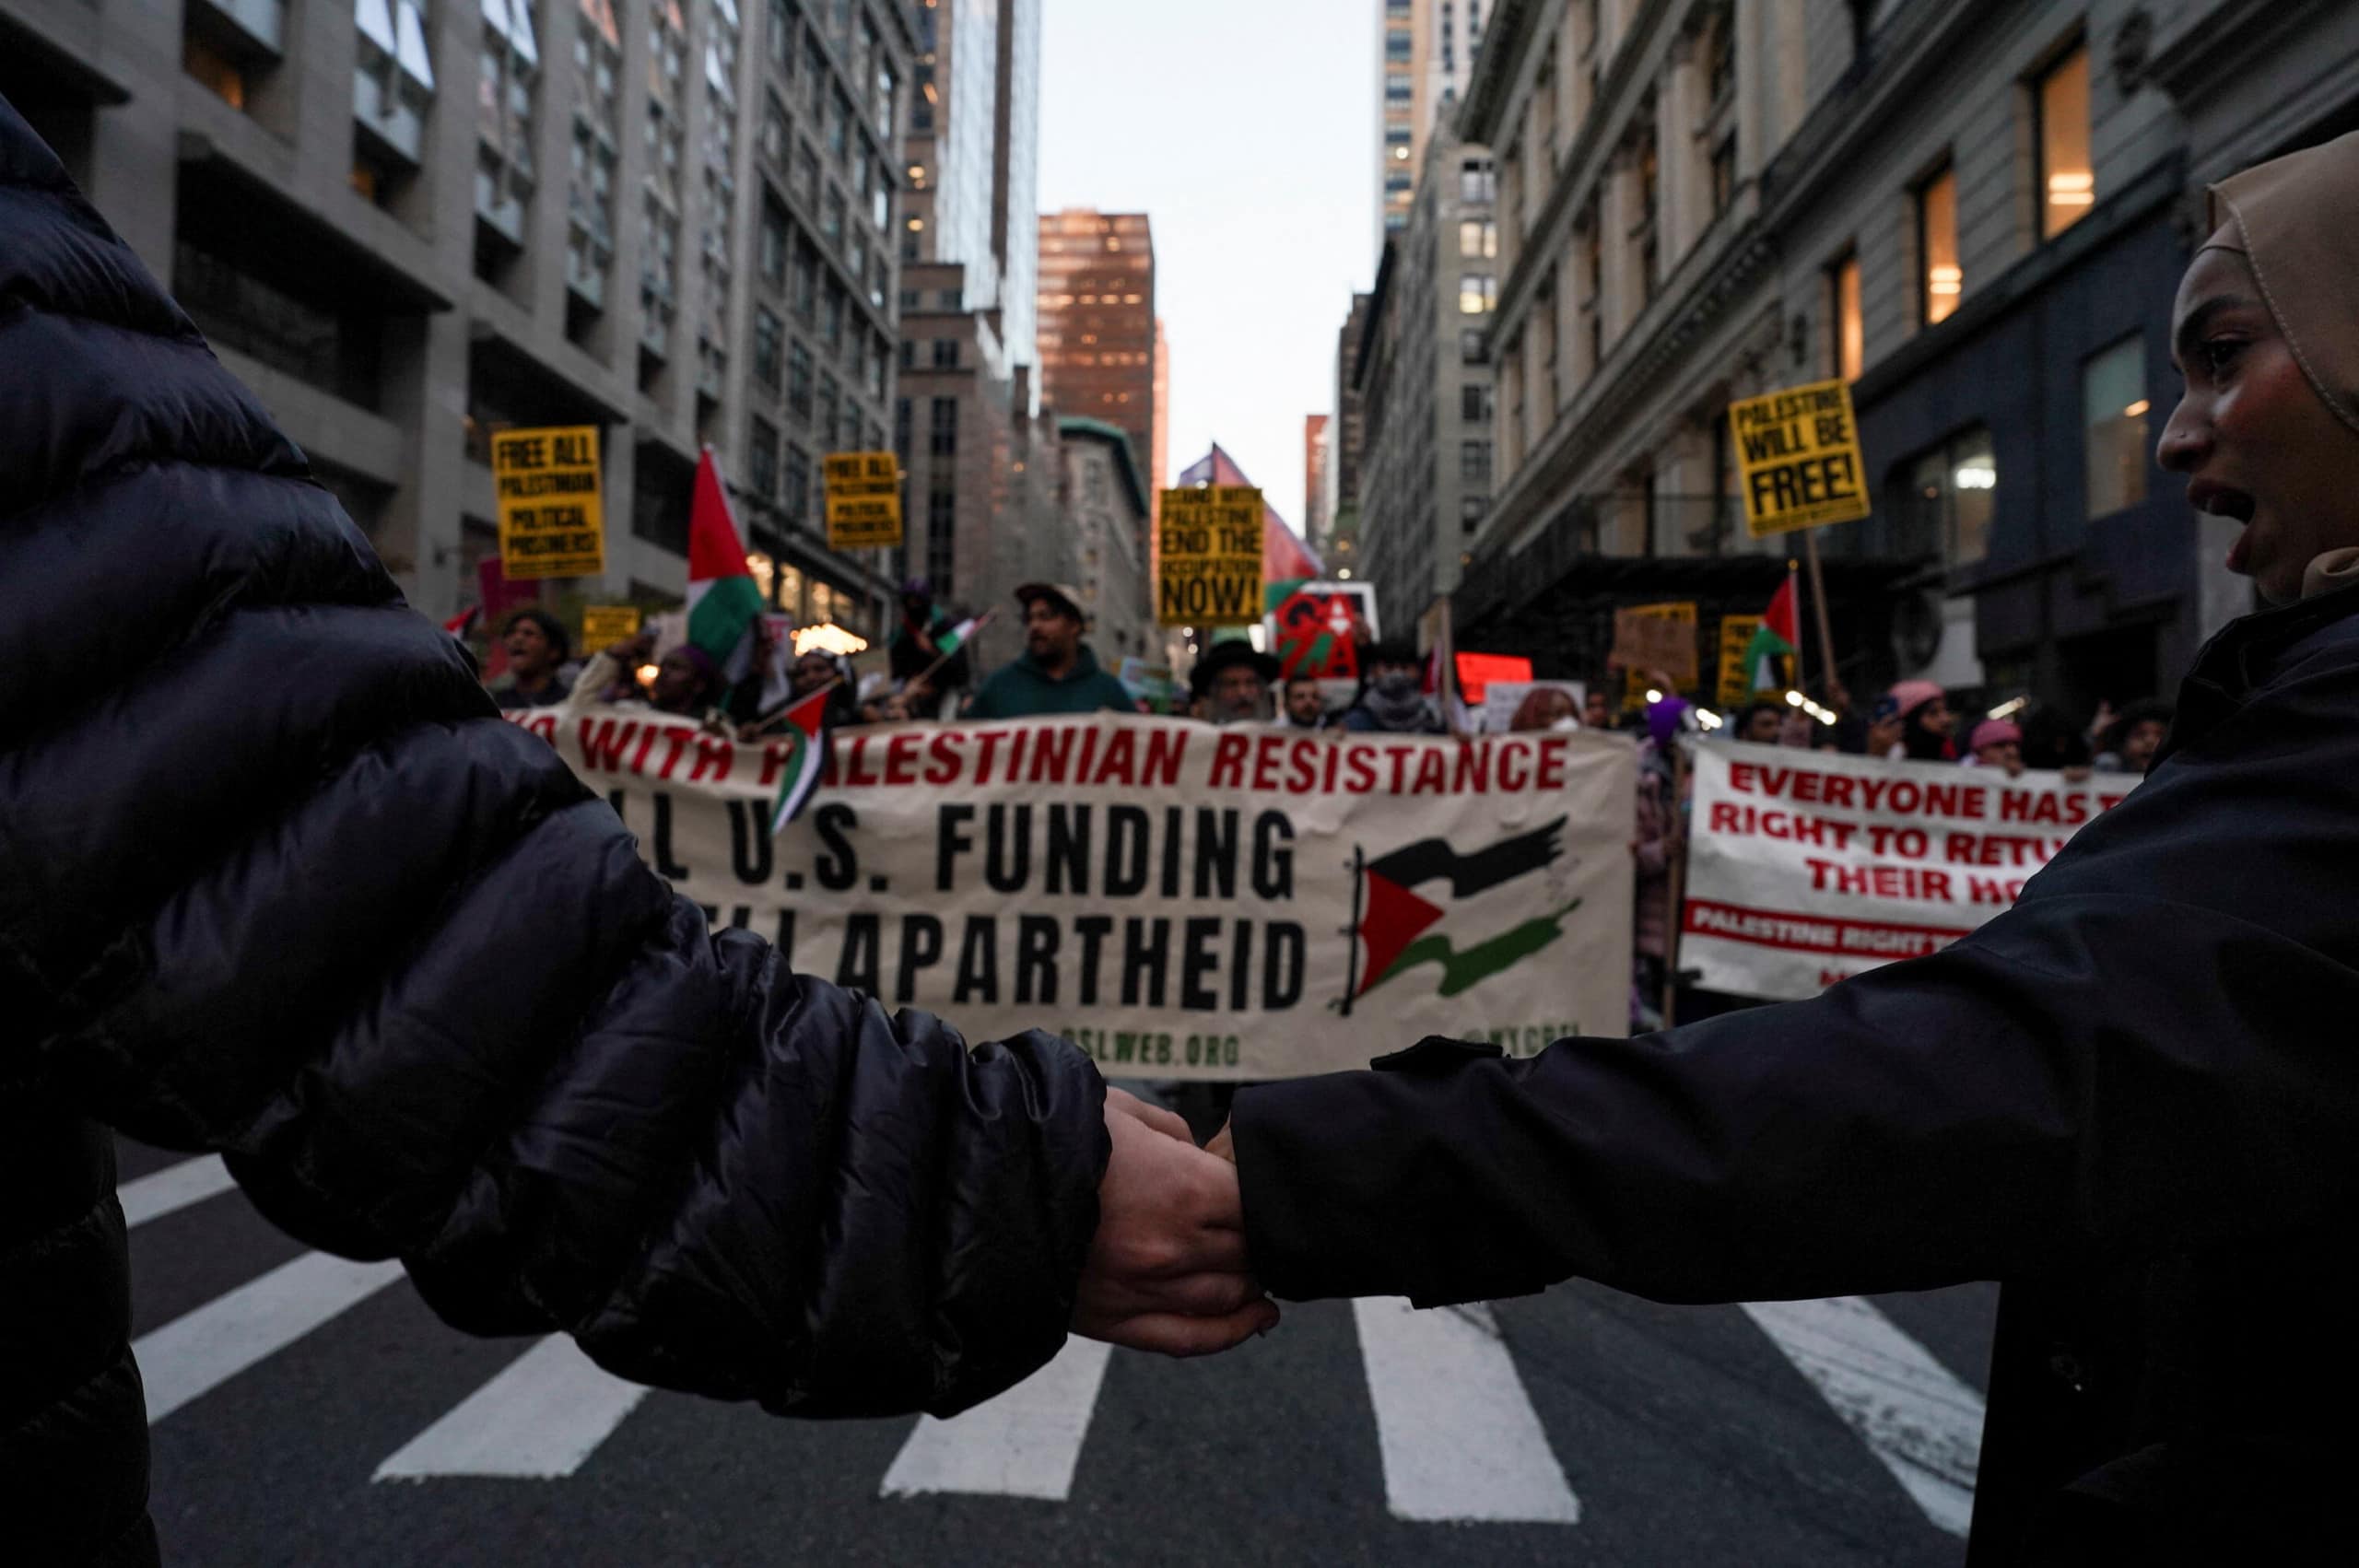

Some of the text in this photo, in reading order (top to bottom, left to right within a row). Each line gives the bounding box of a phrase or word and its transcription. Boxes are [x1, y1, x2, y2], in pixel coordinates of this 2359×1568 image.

[1738, 387, 1841, 429] PALESTINE
[499, 436, 593, 470] FREE ALL
[1743, 414, 1852, 462] WILL BE
[1750, 452, 1858, 515] FREE!
[1161, 527, 1263, 555] END THE
[1162, 577, 1259, 614] NOW!
[579, 717, 734, 782] WITH
[1208, 732, 1568, 795] RESISTANCE
[1729, 760, 2089, 825] EVERYONE HAS
[724, 798, 890, 892] U.S.
[935, 802, 1297, 902] FUNDING
[1709, 801, 1858, 851] RIGHT
[1868, 824, 1930, 860] TO
[1805, 857, 1954, 903] THEIR
[1692, 907, 1837, 947] PALESTINE
[1841, 924, 1928, 955] RIGHT
[834, 912, 1307, 1012] APARTHEID
